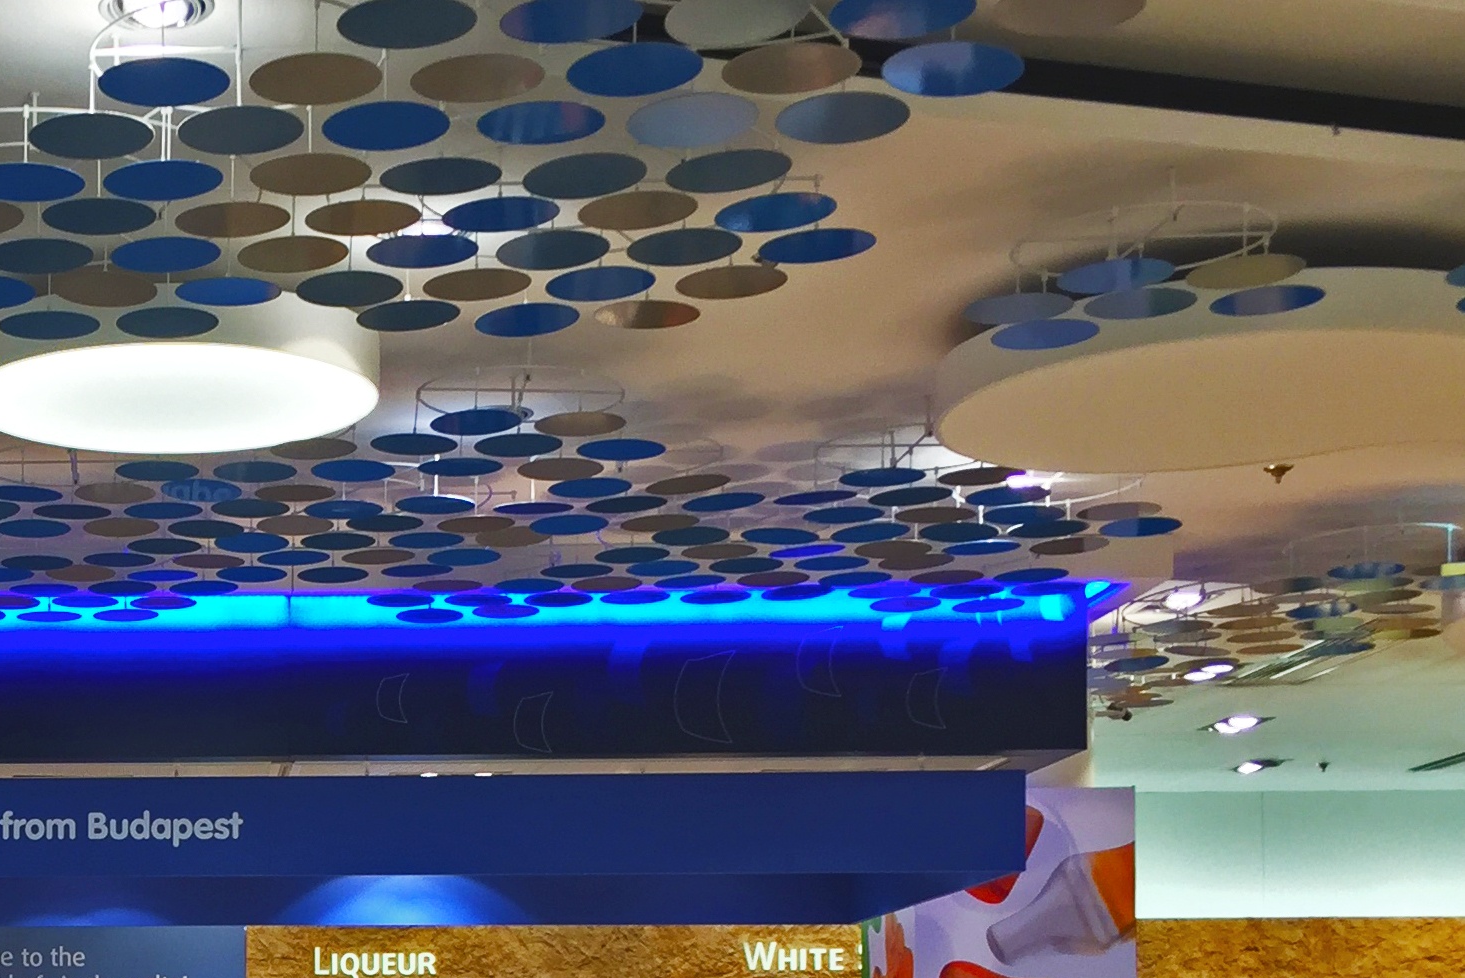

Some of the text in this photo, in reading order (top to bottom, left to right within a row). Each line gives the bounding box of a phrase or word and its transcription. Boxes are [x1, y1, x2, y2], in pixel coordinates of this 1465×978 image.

[0, 810, 77, 841] from
[87, 810, 244, 847] Budapest
[22, 948, 42, 968] to
[50, 945, 85, 968] the
[742, 941, 844, 971] WHITE
